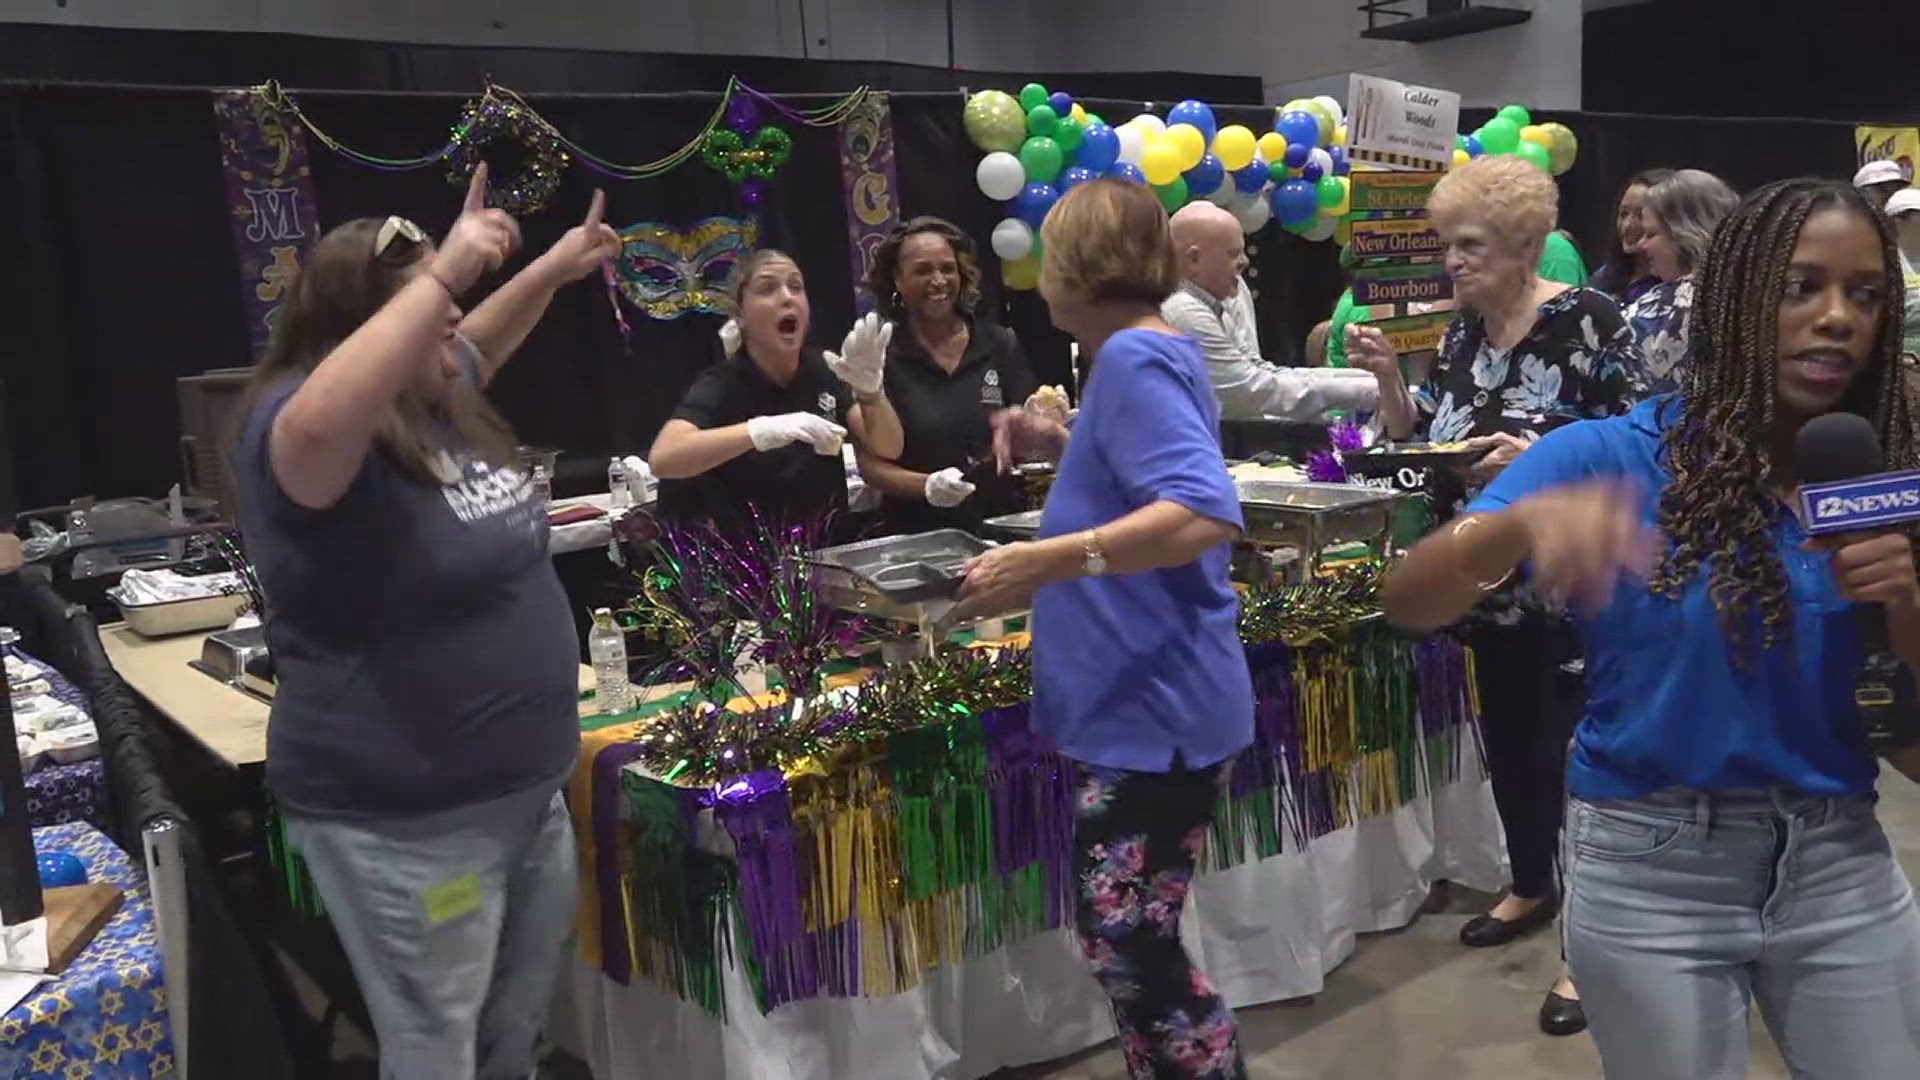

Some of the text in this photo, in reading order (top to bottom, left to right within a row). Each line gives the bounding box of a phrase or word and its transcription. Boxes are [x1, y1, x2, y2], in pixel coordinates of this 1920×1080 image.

[1404, 91, 1439, 107] Calder
[1355, 232, 1441, 252] New Orlean
[1368, 280, 1439, 299] Bourbon
[1397, 466, 1427, 488] Or
